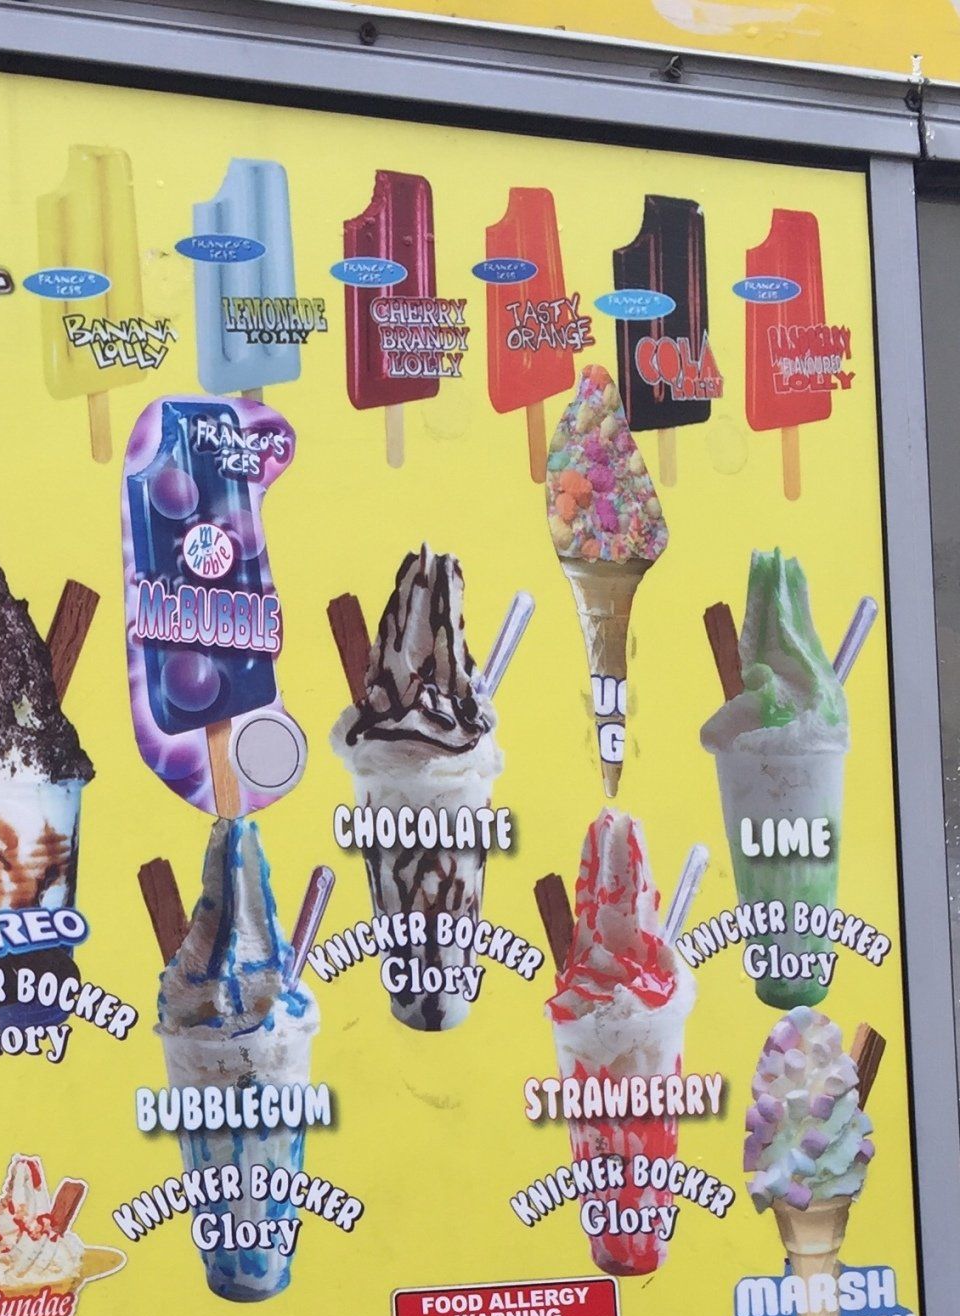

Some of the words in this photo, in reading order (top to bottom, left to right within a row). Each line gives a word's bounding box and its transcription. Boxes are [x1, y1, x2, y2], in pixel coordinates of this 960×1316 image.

[221, 297, 328, 333] LEMONADE
[370, 297, 468, 327] CHERRY
[505, 292, 581, 327] TASTY
[62, 314, 180, 347] BANANA
[246, 330, 310, 344] LOLLY
[379, 326, 471, 352] BRANDY
[505, 316, 596, 352] ORANGE
[91, 341, 169, 370] LOLLY
[387, 351, 463, 378] LOLLY
[635, 329, 720, 385] COLA
[773, 372, 856, 394] LOLLY
[197, 419, 286, 456] FRANCO'S
[333, 803, 512, 851] CHOCOLATE
[741, 817, 832, 858] LIME
[307, 910, 426, 983] KNICKER
[437, 910, 545, 981] BOCKER
[676, 900, 786, 969] KNICKER
[793, 900, 891, 968] BOCKER
[380, 956, 486, 1002] Glory
[742, 944, 838, 985] Glory
[15, 968, 138, 1040] BOCKER
[136, 1082, 332, 1132] BUBBLEGUM
[524, 1072, 724, 1121] STRAWBERRY
[112, 1163, 241, 1242] KNICKER
[251, 1163, 365, 1233] BOCKER
[509, 1155, 625, 1228] KNICKER
[634, 1154, 736, 1220] BOCKER
[190, 1209, 302, 1255] Glory
[580, 1198, 681, 1241] Glory
[422, 1295, 483, 1315] FOOD
[489, 1287, 589, 1310] ALLERGY
